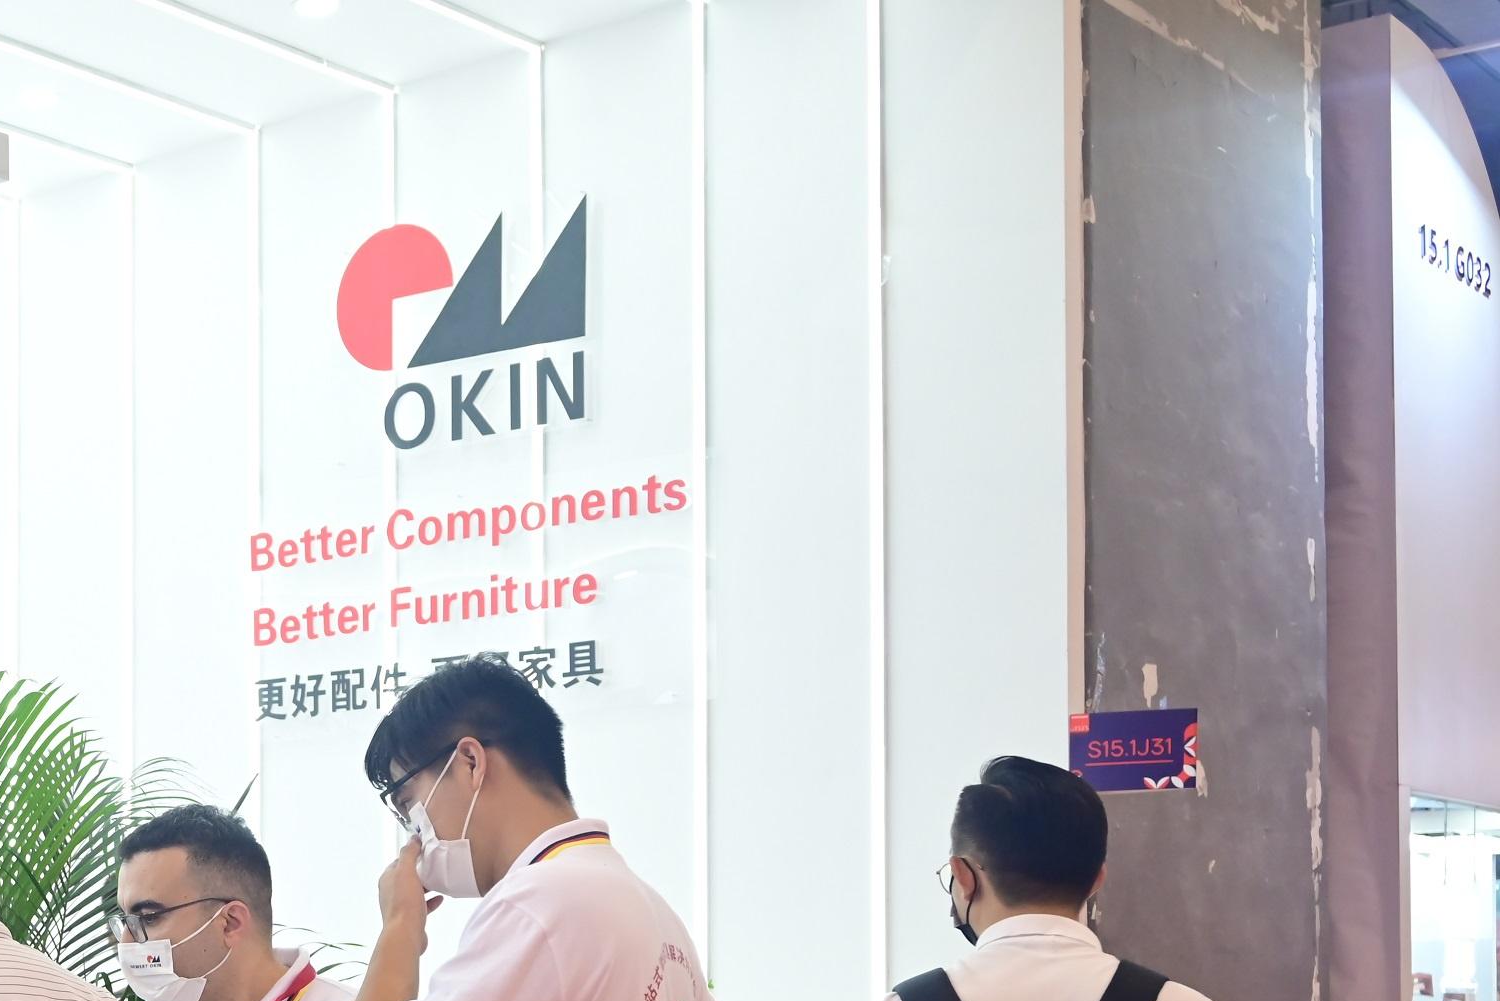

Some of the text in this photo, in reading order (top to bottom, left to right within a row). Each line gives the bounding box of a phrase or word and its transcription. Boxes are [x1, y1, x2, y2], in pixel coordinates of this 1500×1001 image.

[384, 350, 585, 450] OKIN
[250, 474, 688, 571] Better Components
[253, 572, 598, 646] Better Furniture
[1087, 737, 1172, 759] S15.1J31
